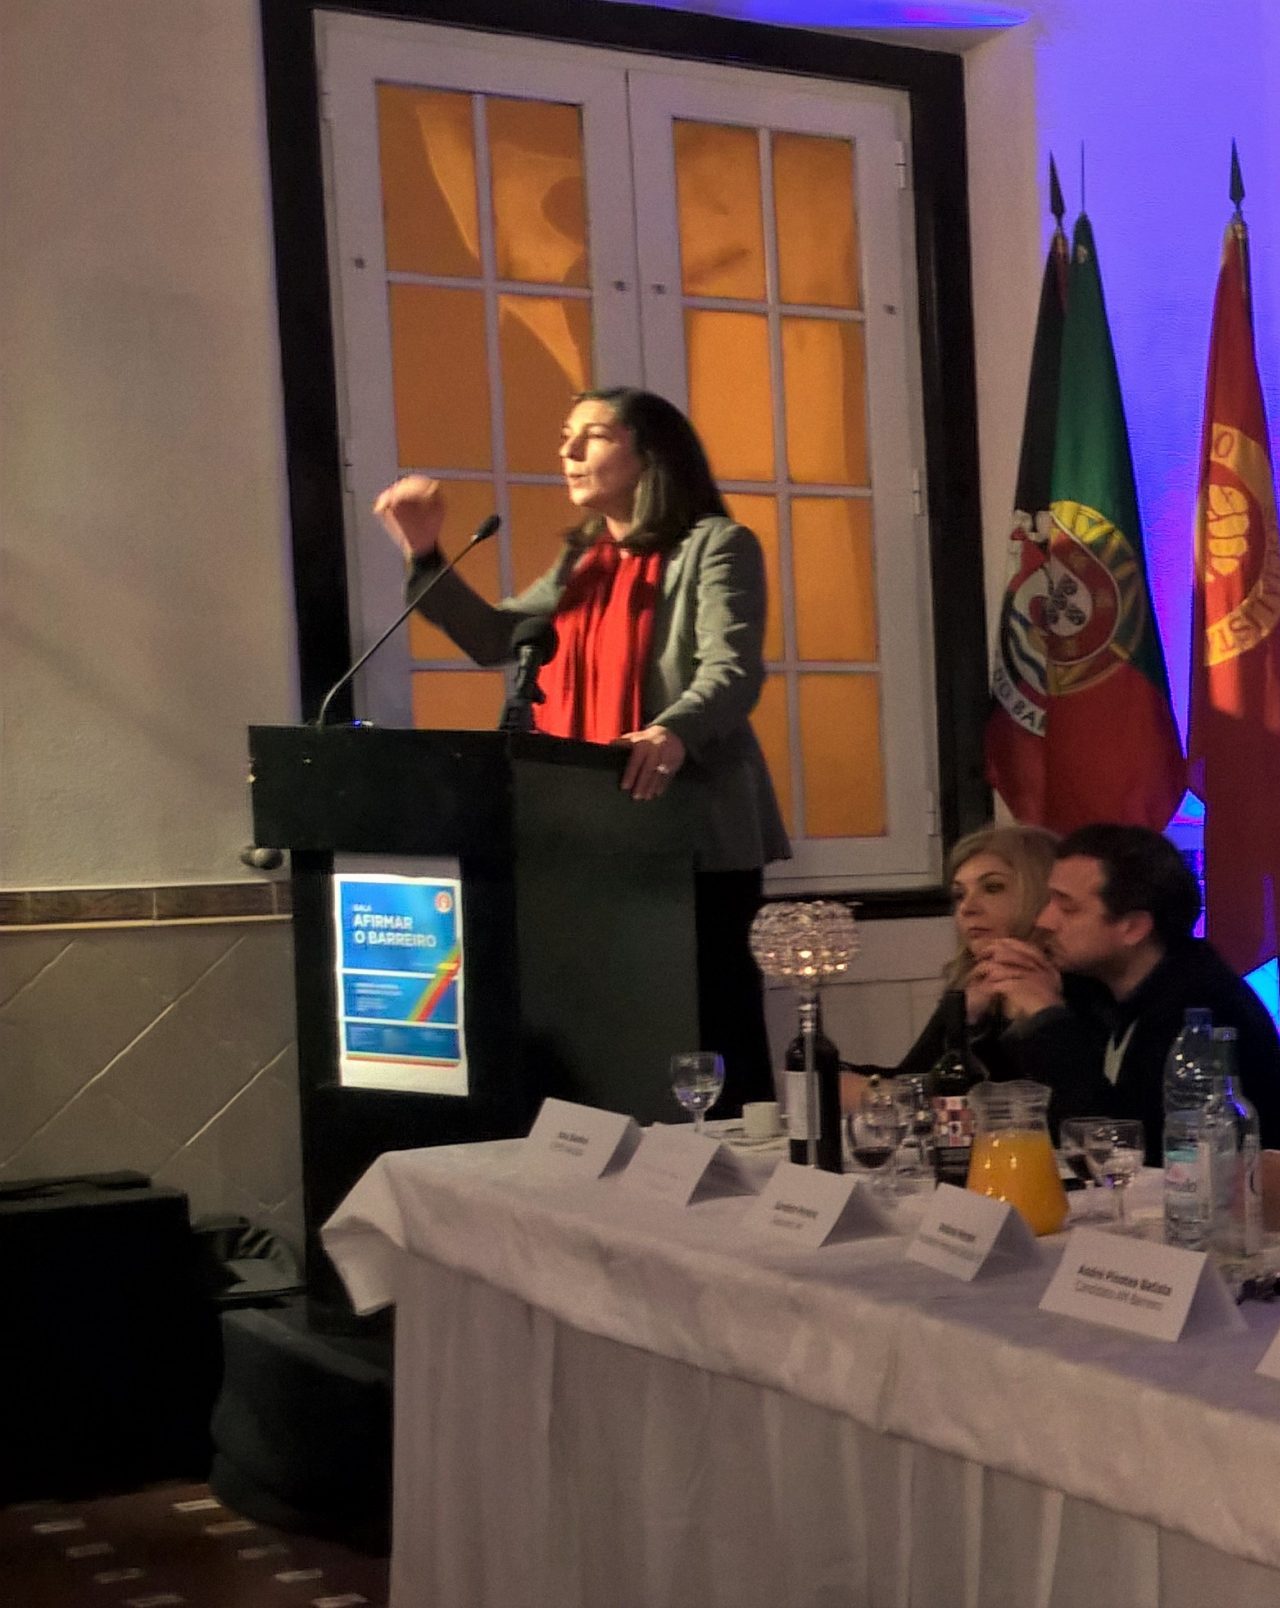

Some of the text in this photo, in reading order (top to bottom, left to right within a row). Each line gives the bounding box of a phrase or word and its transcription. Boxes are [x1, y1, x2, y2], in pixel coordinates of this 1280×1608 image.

[353, 914, 413, 930] AFIRMAR
[355, 930, 437, 948] O BARREIRO
